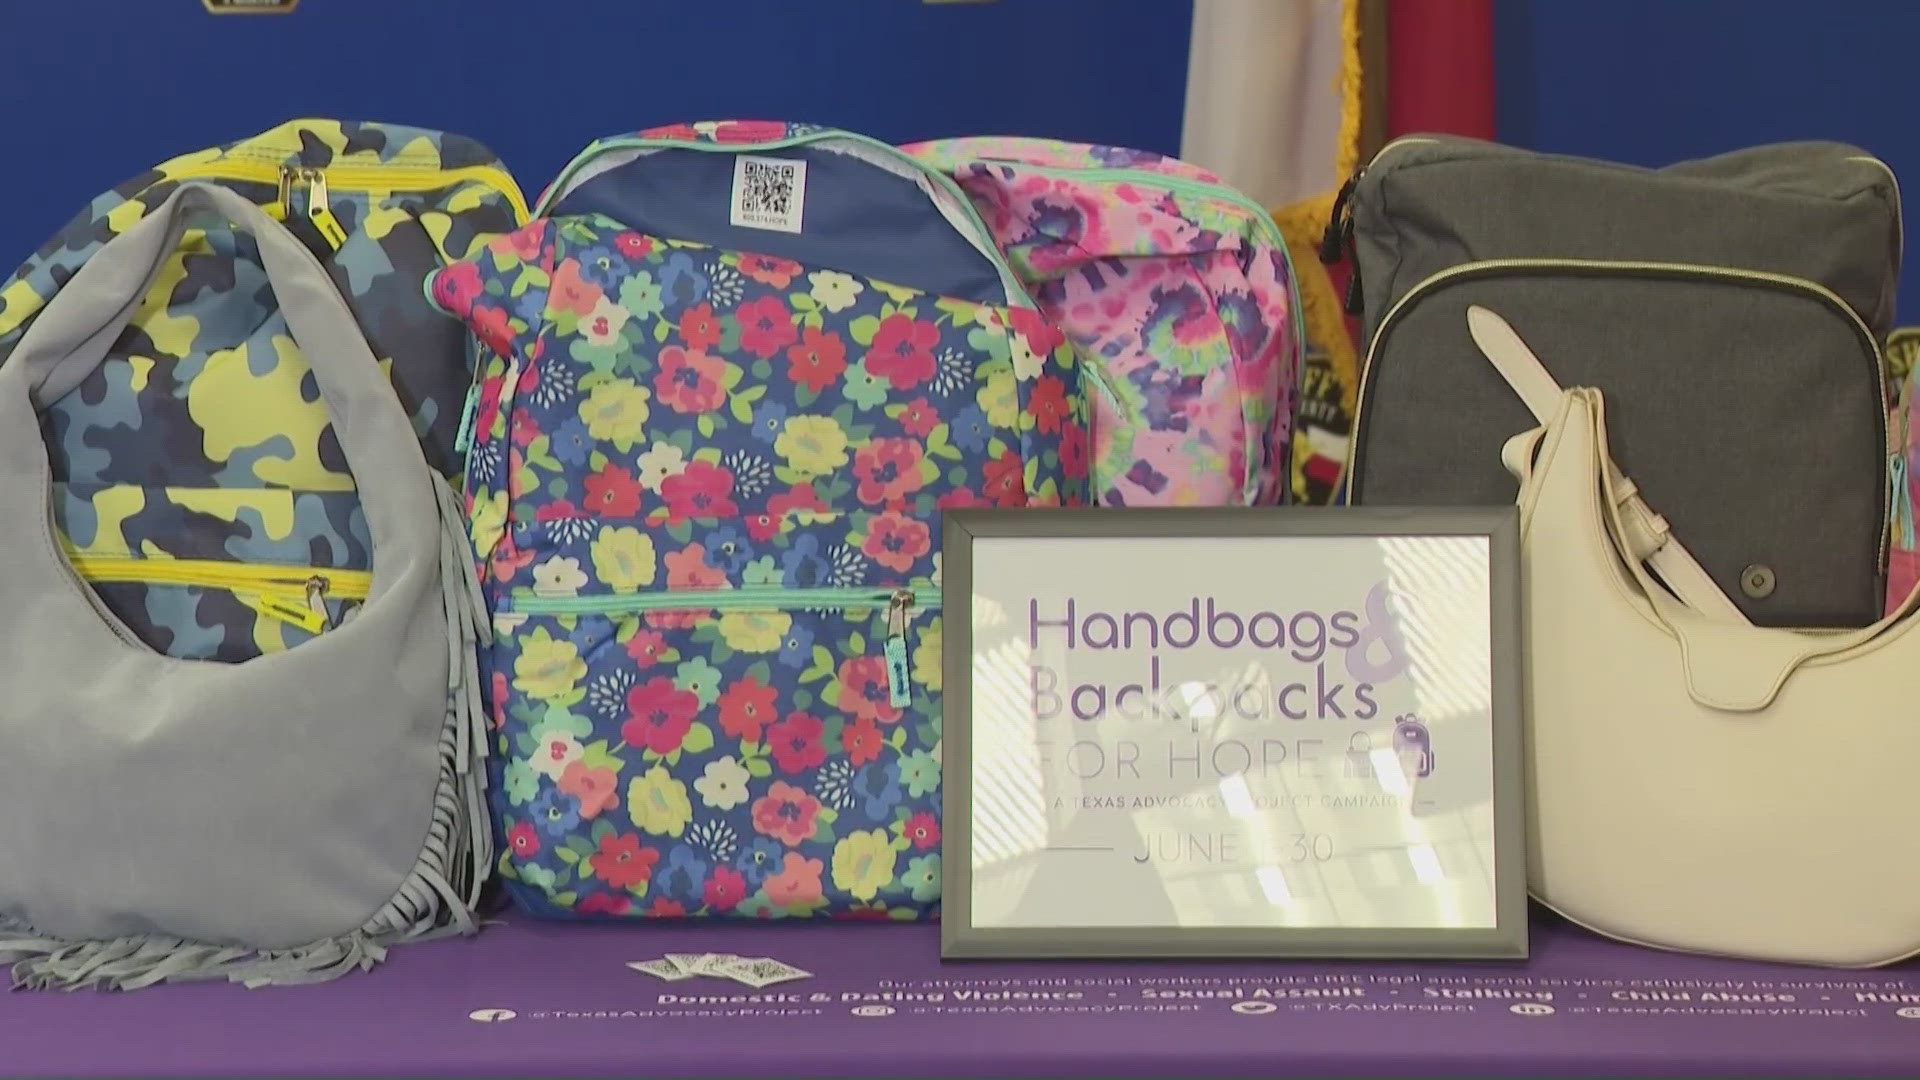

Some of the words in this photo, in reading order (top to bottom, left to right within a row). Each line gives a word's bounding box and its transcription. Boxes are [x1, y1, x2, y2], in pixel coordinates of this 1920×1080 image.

[1030, 597, 1360, 663] Handbags
[1345, 579, 1411, 684] &
[1030, 655, 1379, 733] Backpacks
[1035, 740, 1140, 778] FOR
[1168, 739, 1324, 779] HOPE
[1053, 796, 1064, 809] A
[1072, 796, 1126, 809] TEXAS
[1133, 832, 1240, 863] JUNE
[657, 993, 801, 1004] Domestic
[809, 992, 832, 1002] &
[841, 990, 946, 1002] Dating
[952, 990, 1084, 1001] Violence
[1141, 988, 1245, 999] Sexual
[1253, 987, 1366, 998] Assault
[1423, 987, 1554, 1001] Stalking
[1611, 990, 1691, 1001] Child
[1701, 991, 1796, 1002] Abuse
[1028, 978, 1067, 986] and
[1139, 976, 1222, 985] workers
[1370, 974, 1420, 985] legal
[1631, 978, 1744, 989] exclusively
[1780, 980, 1878, 989] survivors
